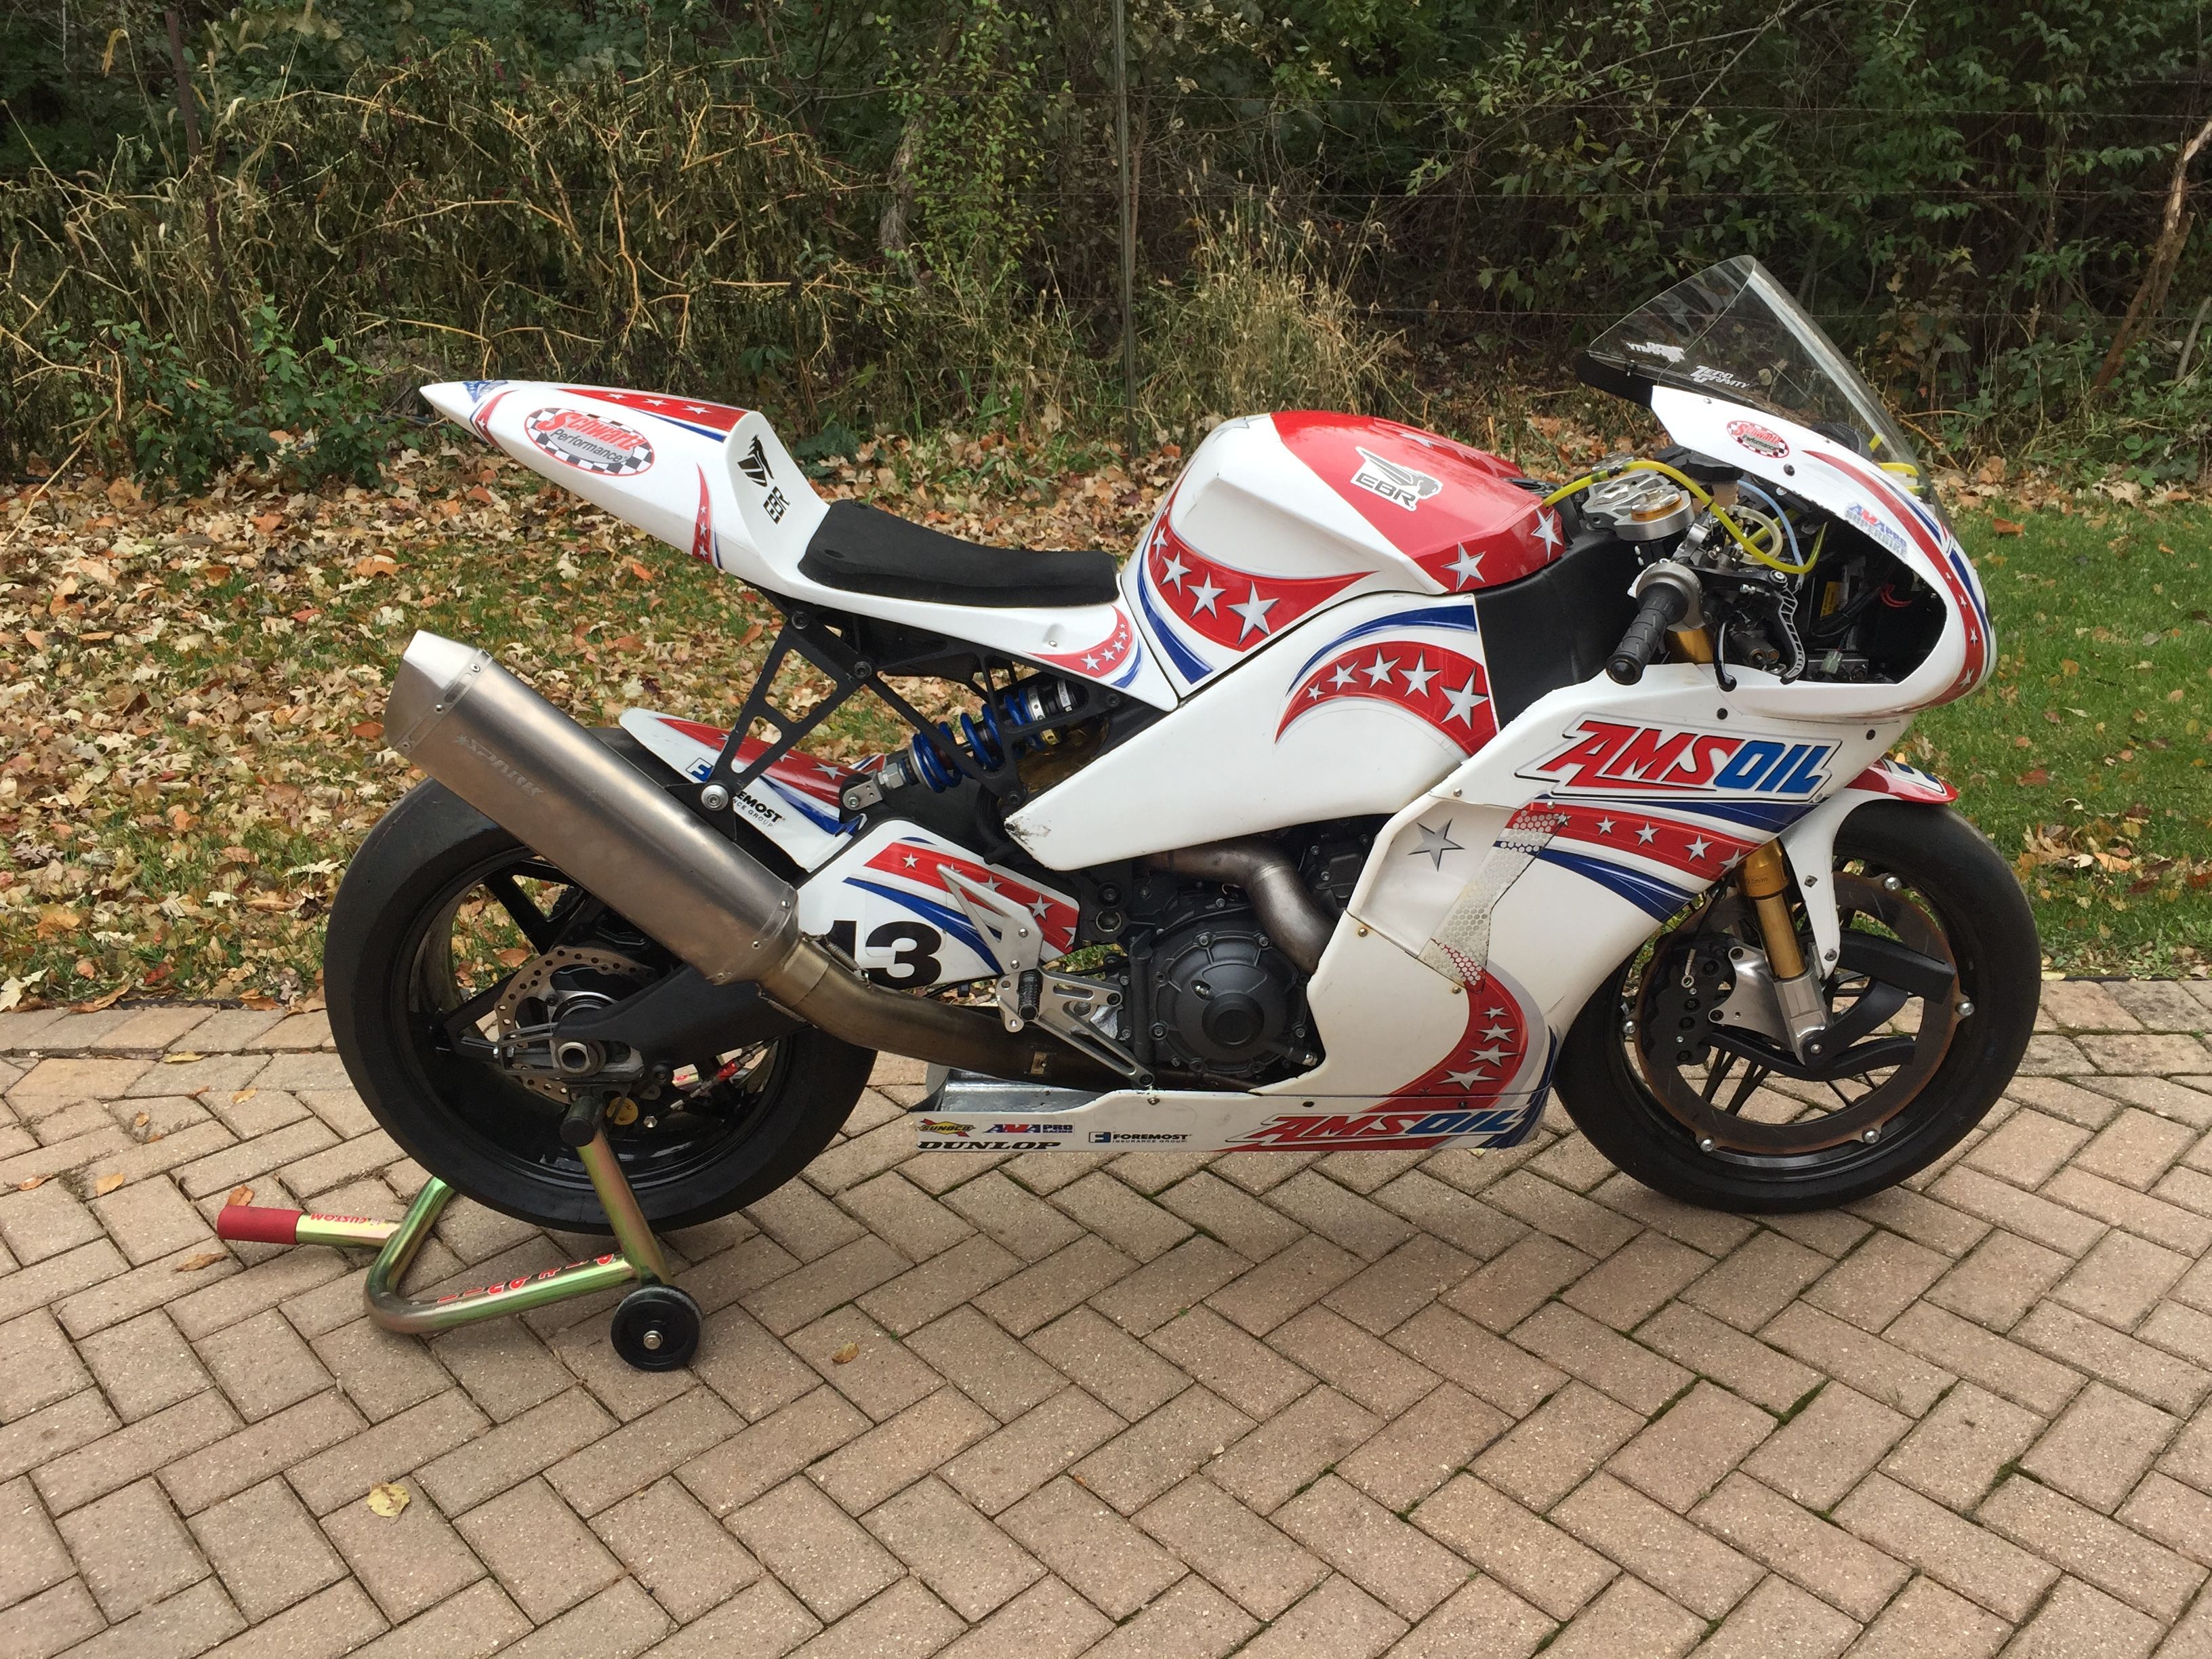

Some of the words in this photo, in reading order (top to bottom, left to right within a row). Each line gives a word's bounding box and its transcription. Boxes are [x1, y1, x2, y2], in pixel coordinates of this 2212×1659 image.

[1689, 365, 1734, 380] ZERO
[1693, 373, 1750, 388] GRAVITY
[535, 411, 647, 451] Schwartz
[550, 428, 623, 462] Performance
[762, 486, 791, 525] EBR
[1355, 472, 1416, 508] EBR
[1845, 510, 1908, 558] SUPERBIKE
[1849, 503, 1885, 533] AMA
[1536, 720, 1832, 793] AMSOIL
[736, 791, 783, 823] EMOST
[748, 810, 774, 827] GROUP
[825, 920, 942, 990] 13
[983, 1124, 1041, 1133] AMA
[1246, 1109, 1521, 1143] AMSOIL
[917, 1141, 1062, 1150] DUNLOP
[310, 1213, 368, 1225] CUSTOM
